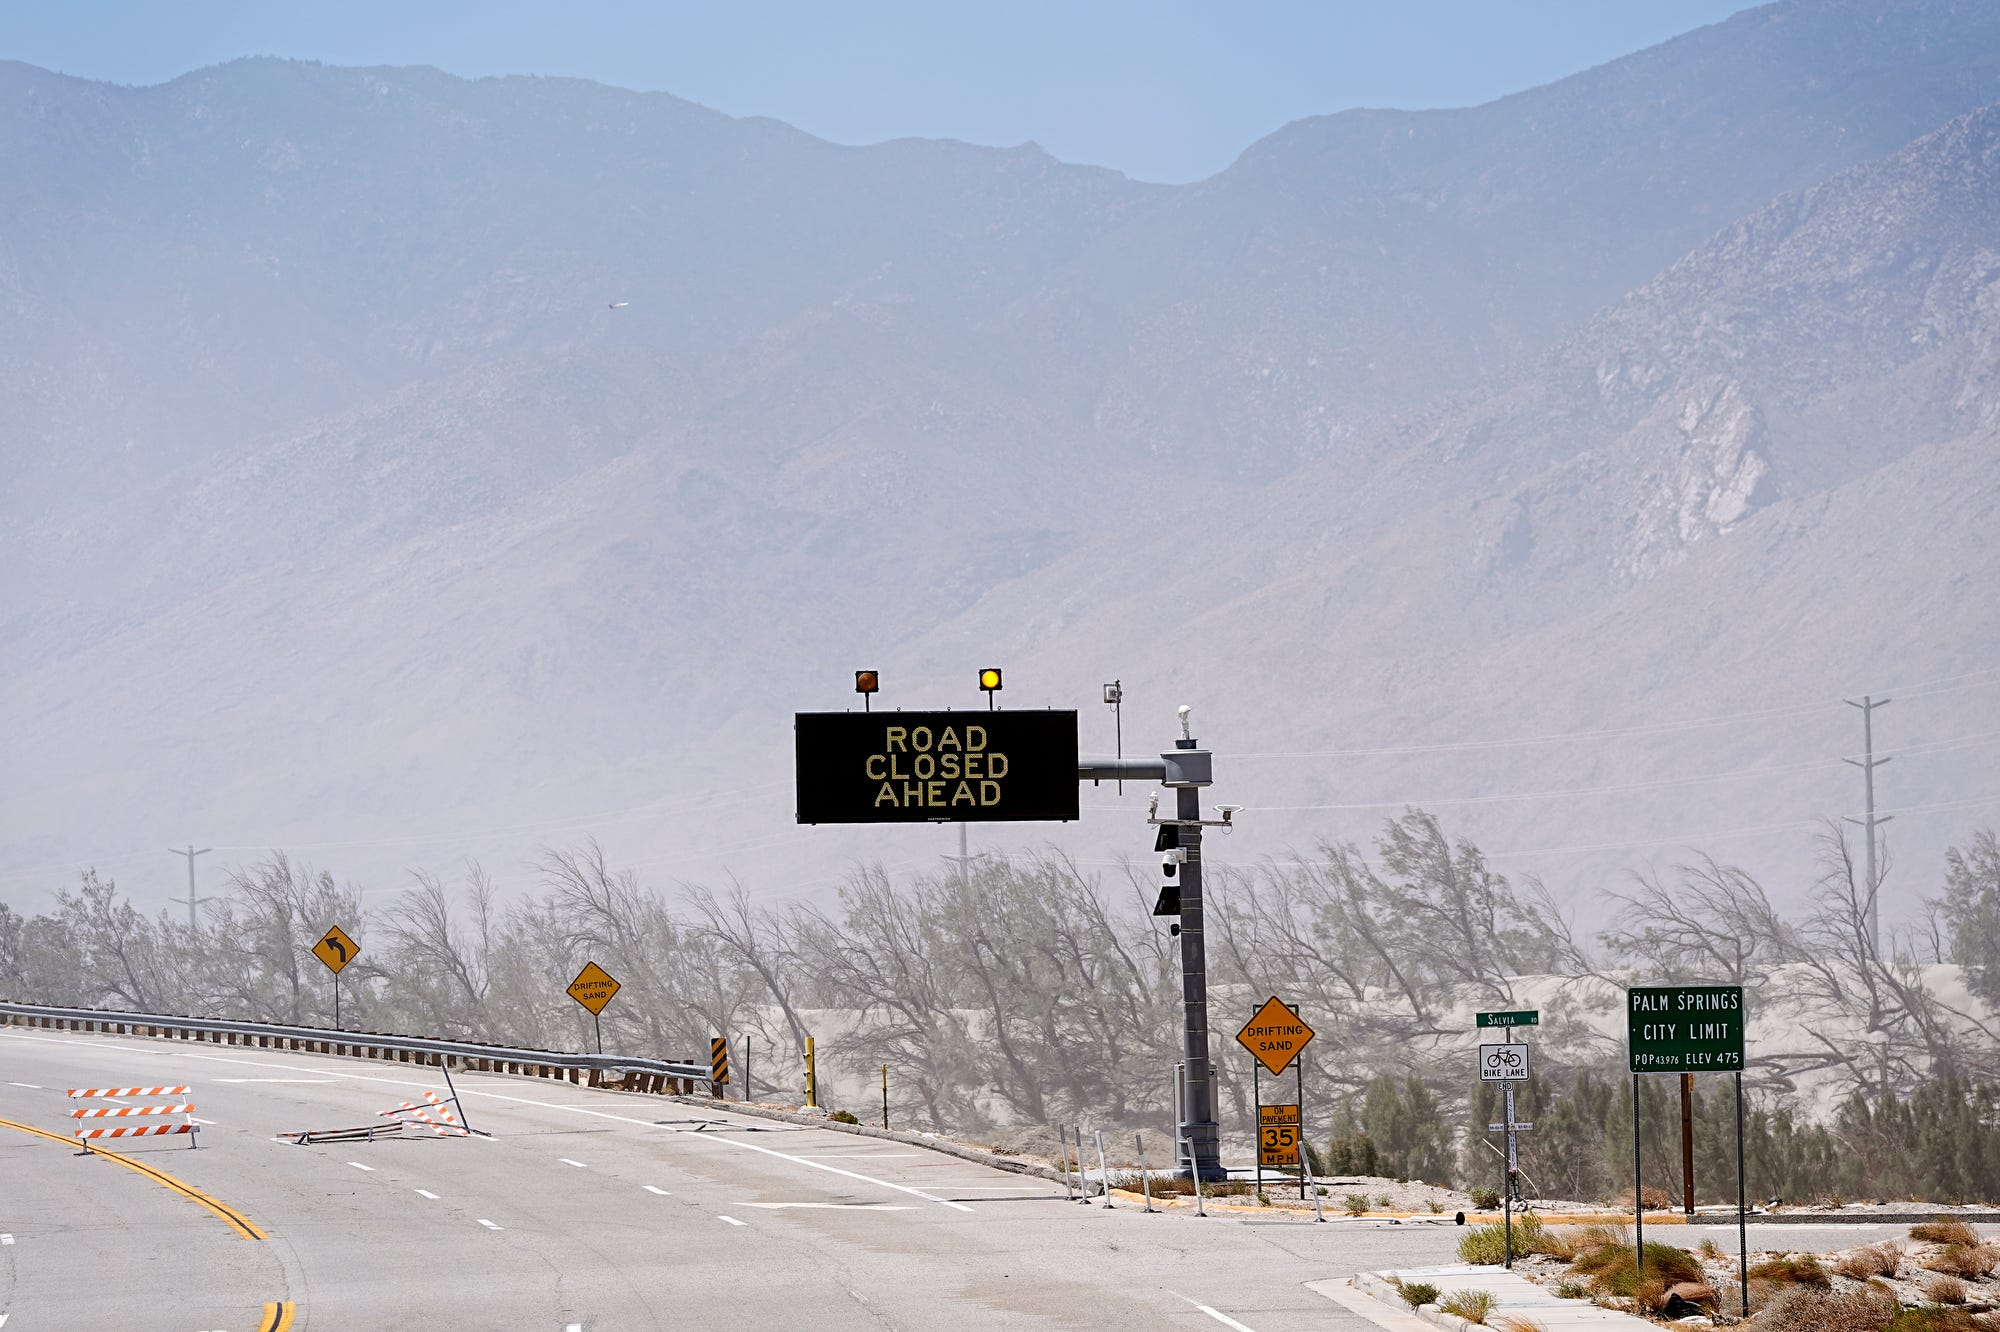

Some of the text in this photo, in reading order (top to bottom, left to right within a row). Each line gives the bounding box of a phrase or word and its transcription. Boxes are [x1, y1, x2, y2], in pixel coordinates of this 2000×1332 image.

[887, 726, 987, 752] ROAD
[866, 753, 1009, 780] CLOSED
[874, 780, 1001, 807] AHEAD
[574, 980, 613, 991] DRIFTING
[583, 991, 607, 1000] SAND
[1633, 993, 1738, 1011] PALM SPRINGS
[1247, 1025, 1303, 1037] DRIFTING
[1644, 1023, 1728, 1040] CITY LIMIT
[1259, 1041, 1293, 1051] SAND
[1686, 1053, 1711, 1064] ELEV
[1716, 1052, 1738, 1064] 475
[1483, 1068, 1525, 1077] BIKE LANE
[1498, 1082, 1511, 1090] END
[1274, 1106, 1284, 1114] ON
[1262, 1114, 1296, 1123] PAVEMENT
[1264, 1129, 1294, 1147] 35
[1266, 1154, 1294, 1163] MPH
